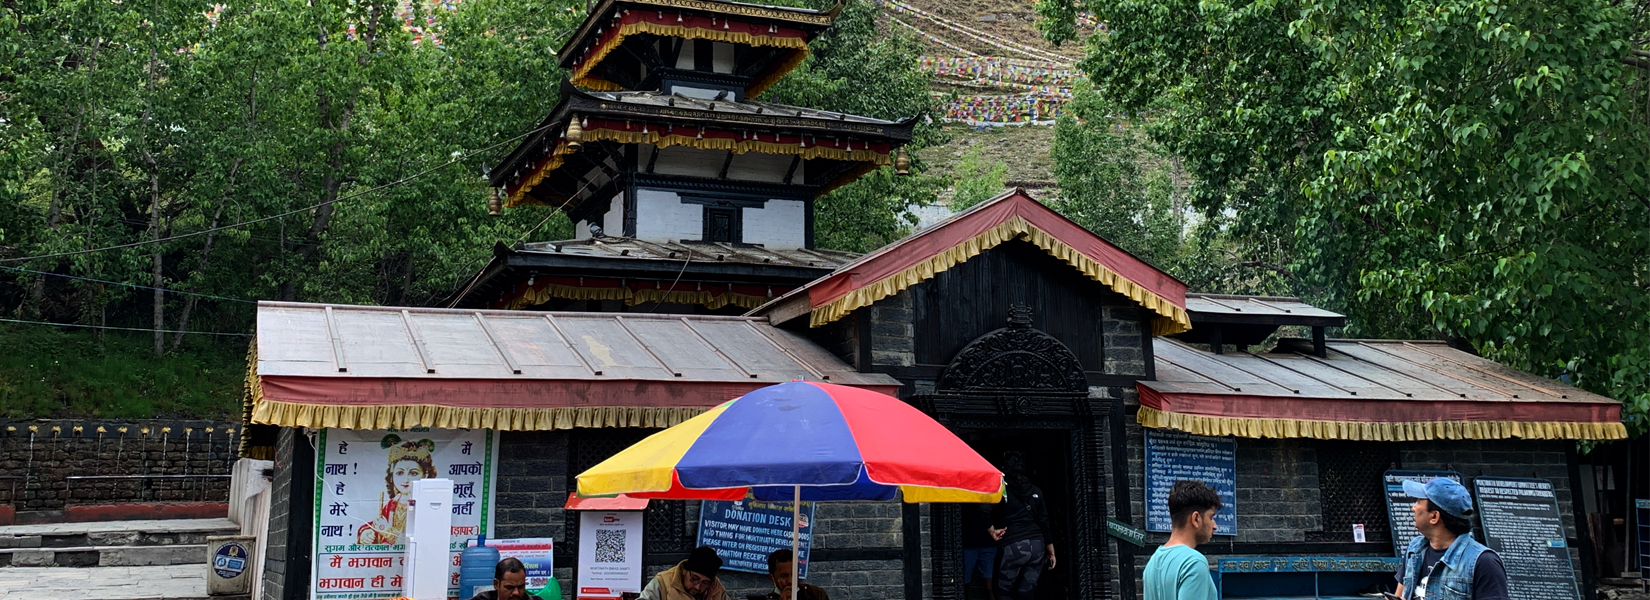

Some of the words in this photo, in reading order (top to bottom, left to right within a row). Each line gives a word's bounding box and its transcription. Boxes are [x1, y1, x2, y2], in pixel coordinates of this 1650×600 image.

[338, 440, 348, 455] हे
[325, 463, 347, 475] नाथ
[449, 461, 483, 475] आपको
[336, 482, 346, 496] हे
[329, 502, 349, 516] मेरे
[452, 502, 475, 515] नहीं
[725, 509, 766, 523] DONATION
[769, 514, 791, 527] DESK
[321, 525, 342, 538] नाथ
[705, 519, 728, 529] VISITOR
[728, 522, 741, 531] MAY
[740, 525, 752, 533] HAVE
[752, 526, 771, 535] DONATE
[771, 528, 783, 537] HERE
[798, 533, 810, 541] OODS
[324, 544, 345, 553] सुगम
[348, 543, 362, 551] और
[702, 537, 722, 547] PLEASE
[746, 543, 768, 553] REGISTER
[329, 554, 343, 568] मैं
[348, 557, 393, 568] भगवान
[319, 577, 365, 589] भगवान
[371, 575, 386, 588] ही
